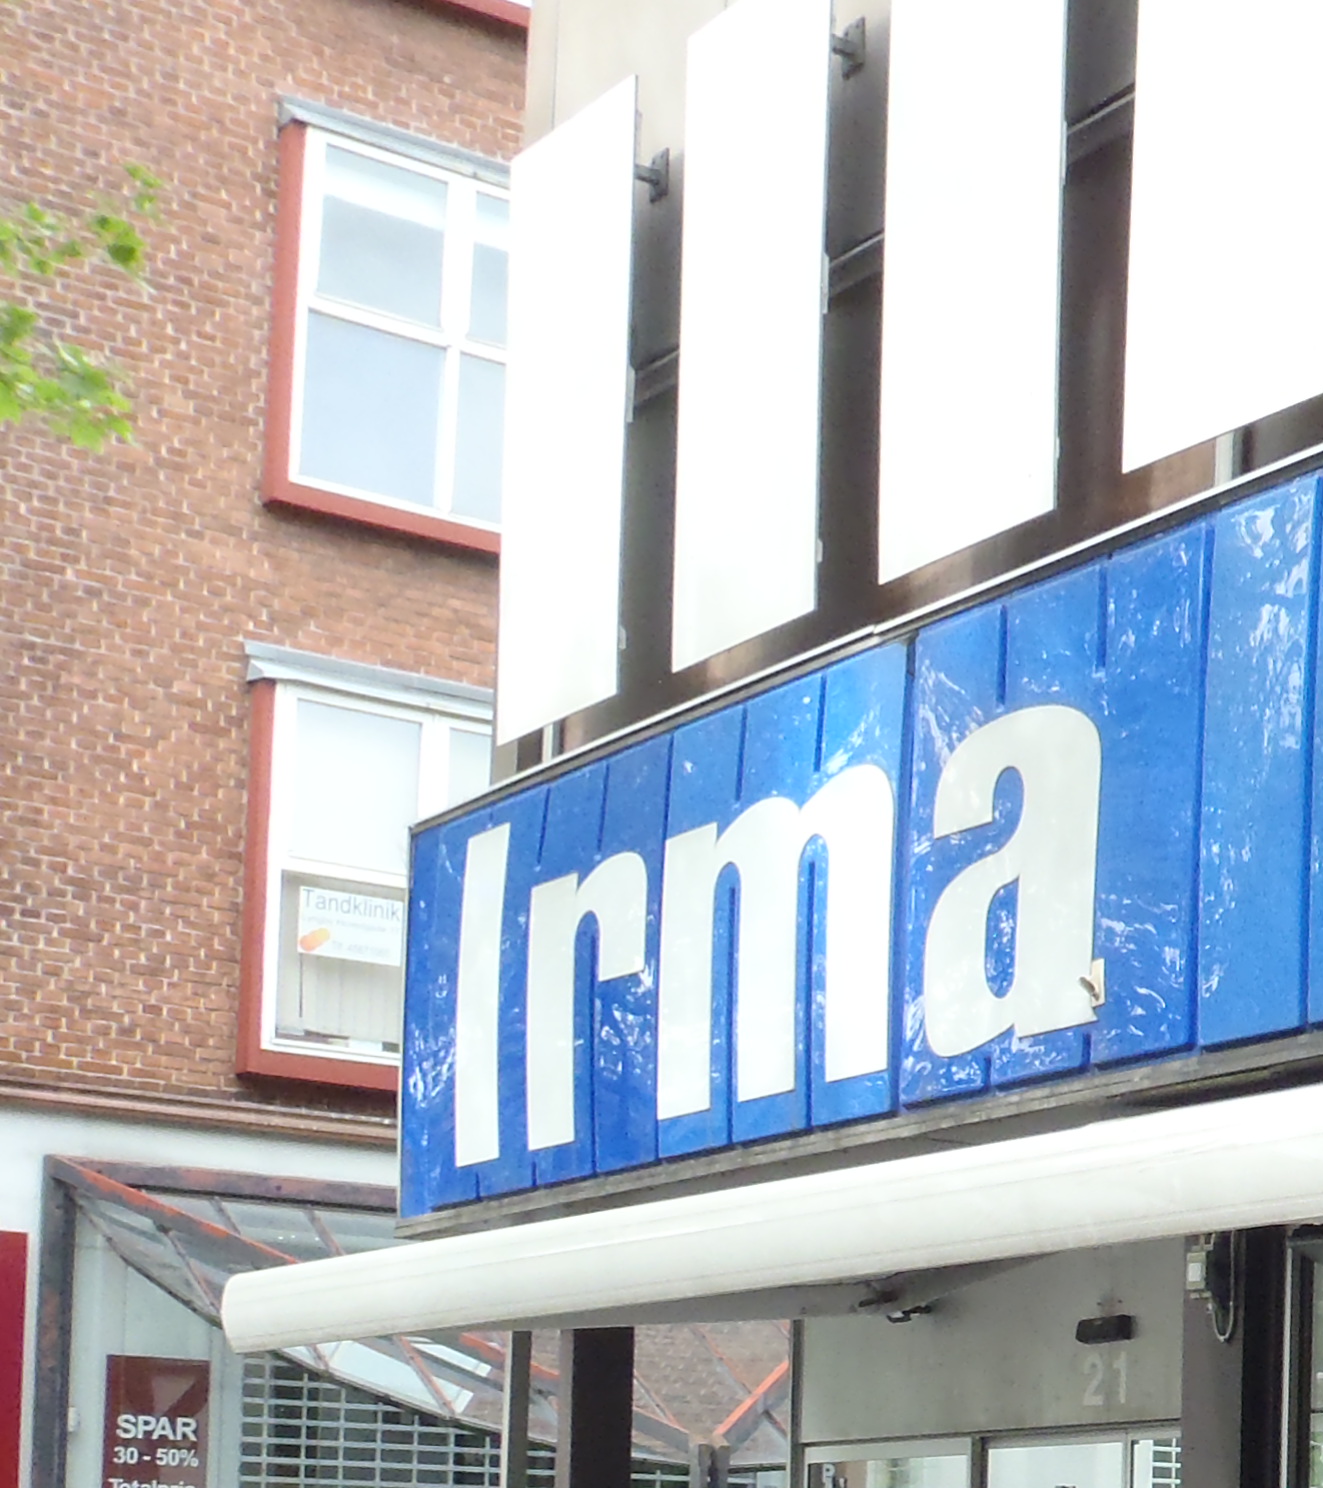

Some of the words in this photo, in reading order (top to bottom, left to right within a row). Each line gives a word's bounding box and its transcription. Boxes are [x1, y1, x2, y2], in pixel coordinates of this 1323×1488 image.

[303, 888, 401, 922] Tandklinik
[455, 704, 1101, 1168] Irma
[1082, 1351, 1128, 1407] 21
[116, 1414, 197, 1441] SPAR
[113, 1446, 138, 1464] 30
[155, 1449, 199, 1467] 50%
